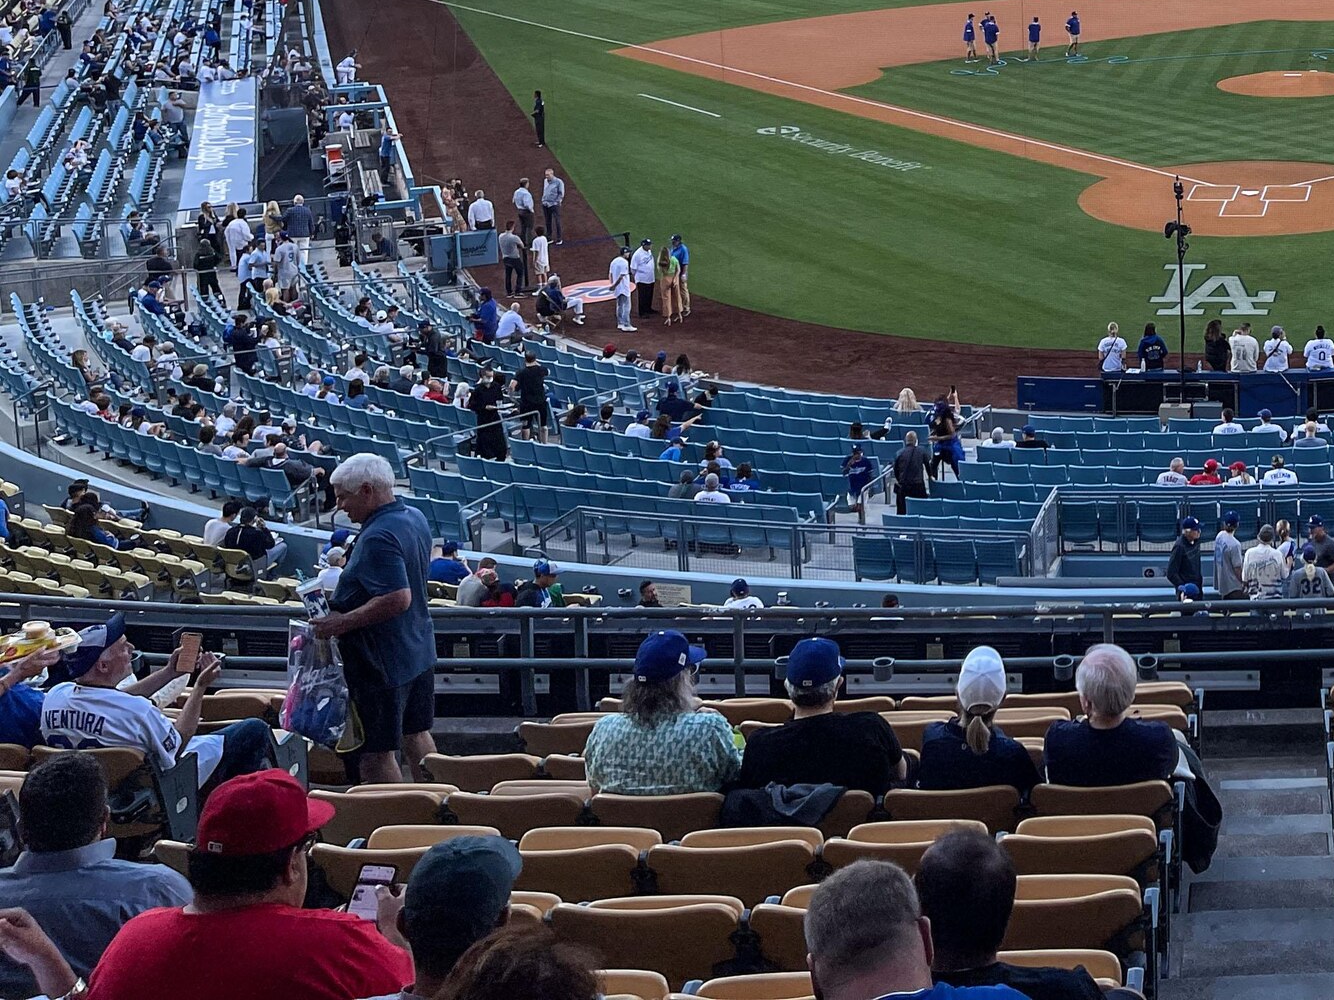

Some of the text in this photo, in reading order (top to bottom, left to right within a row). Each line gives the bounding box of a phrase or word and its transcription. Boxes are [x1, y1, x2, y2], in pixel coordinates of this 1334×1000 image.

[1149, 263, 1277, 316] LA
[1318, 350, 1326, 361] 0
[1301, 577, 1322, 595] 32
[44, 709, 105, 736] VENTURA
